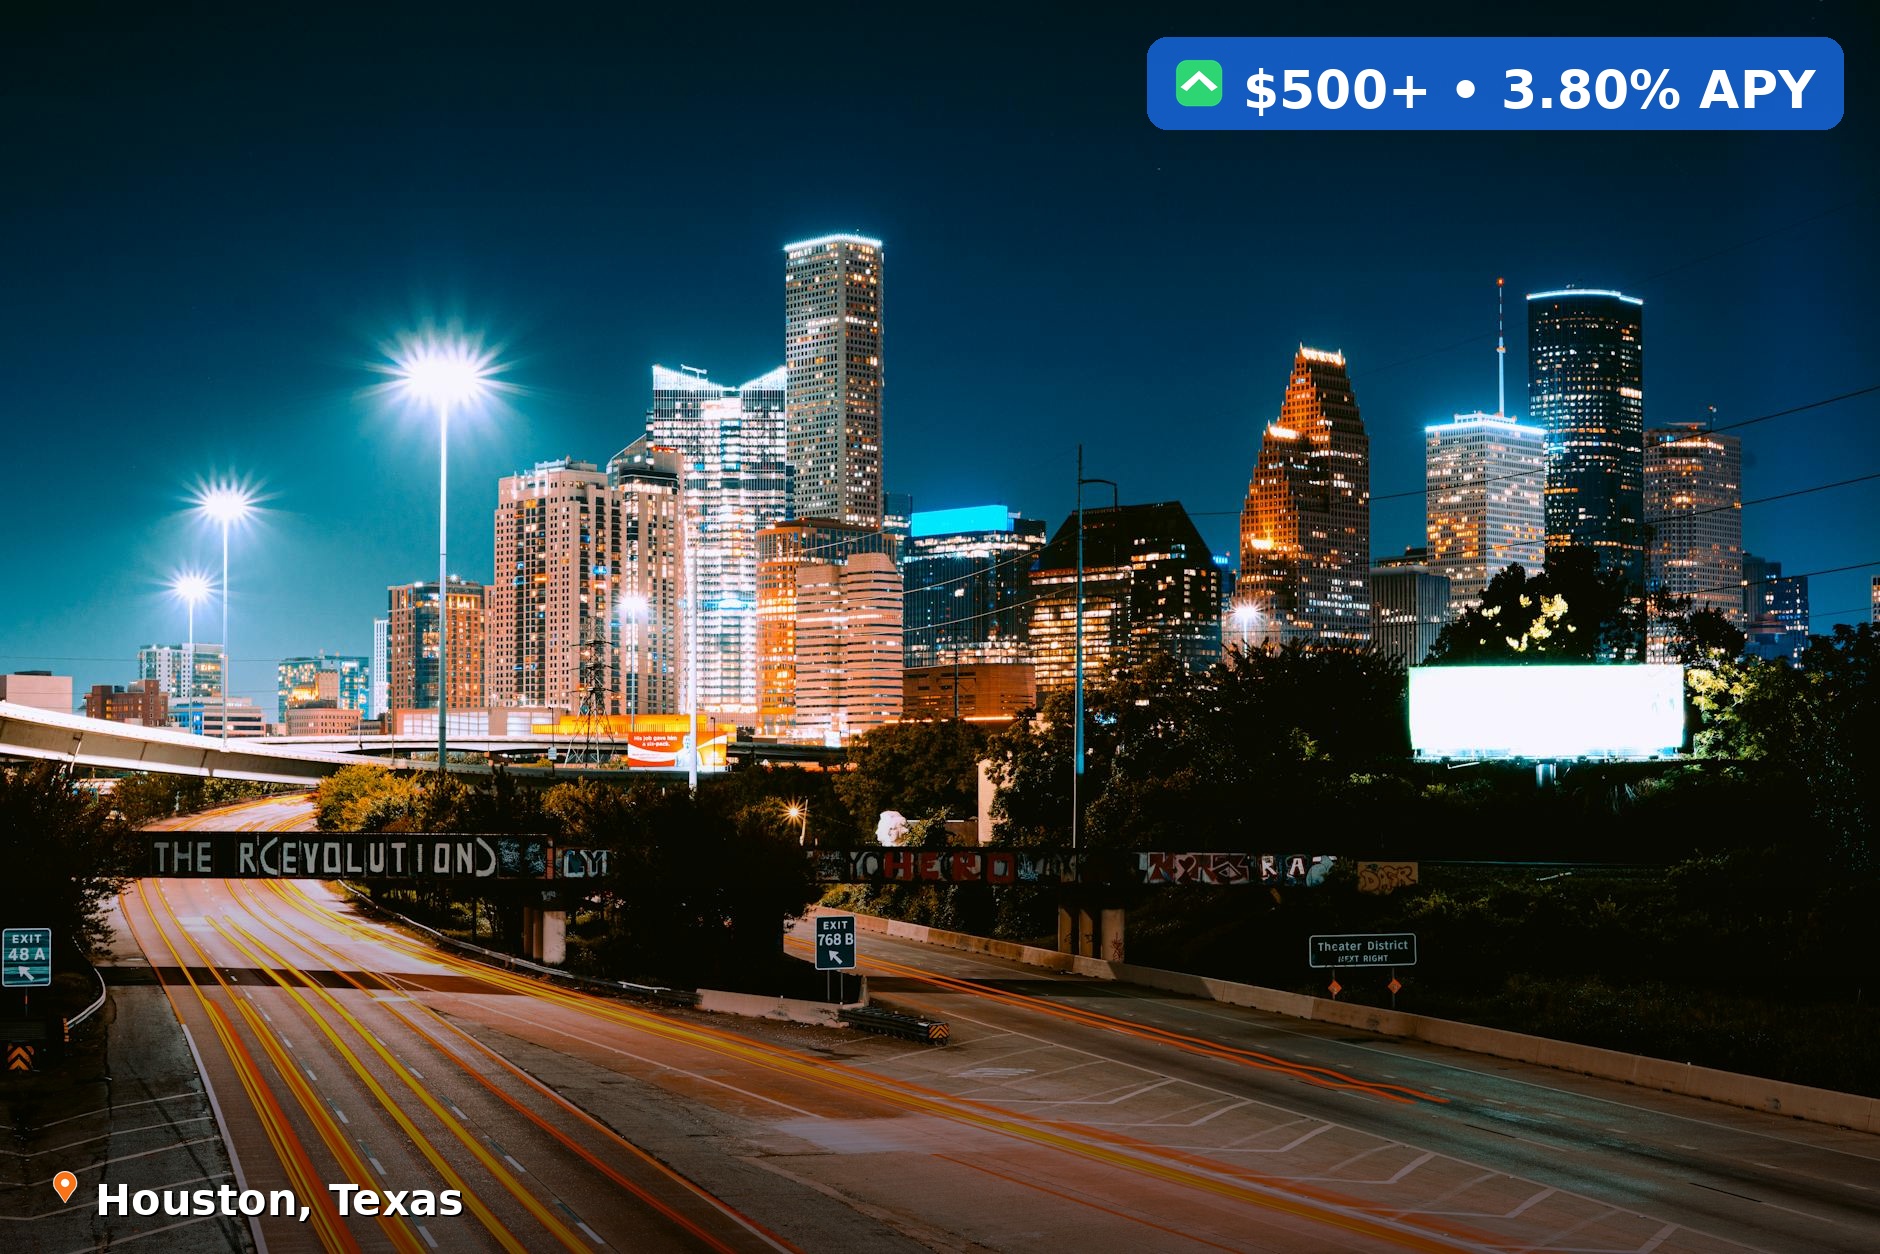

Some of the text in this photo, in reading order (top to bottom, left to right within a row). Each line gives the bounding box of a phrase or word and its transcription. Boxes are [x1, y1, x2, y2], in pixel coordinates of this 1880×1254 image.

[154, 842, 211, 873] THE
[240, 837, 496, 877] R(EVOLUTION)
[823, 921, 848, 930] EXIT
[12, 934, 42, 944] EXIT
[818, 932, 854, 946] 768 B
[1317, 940, 1408, 952] Theater District
[8, 947, 46, 961] 48 A
[1337, 954, 1389, 963] NEXT RIGHT
